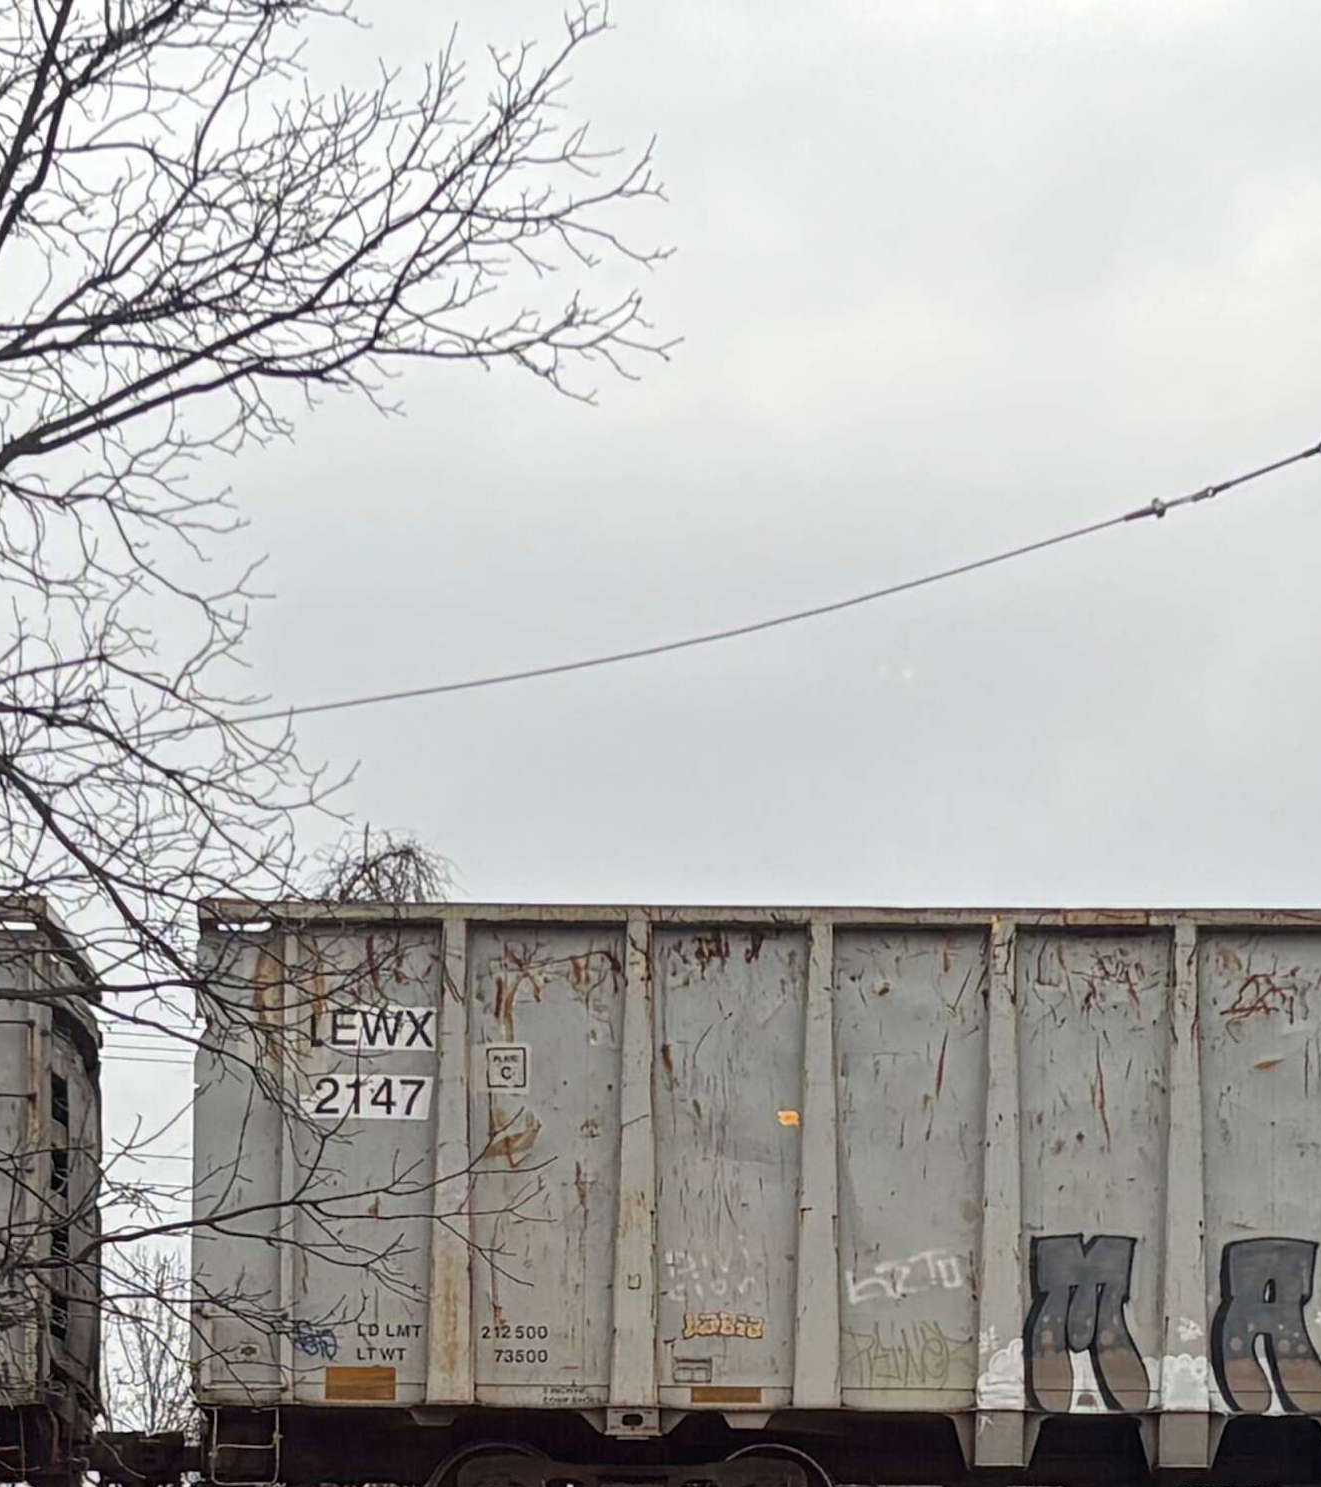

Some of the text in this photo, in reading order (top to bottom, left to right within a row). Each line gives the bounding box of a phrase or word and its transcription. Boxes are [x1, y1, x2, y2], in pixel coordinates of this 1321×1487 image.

[500, 1065, 513, 1081] C
[314, 1077, 426, 1116] 2147
[357, 1324, 548, 1340] LD LMT 212500
[357, 1348, 548, 1363] LT WT 73500
